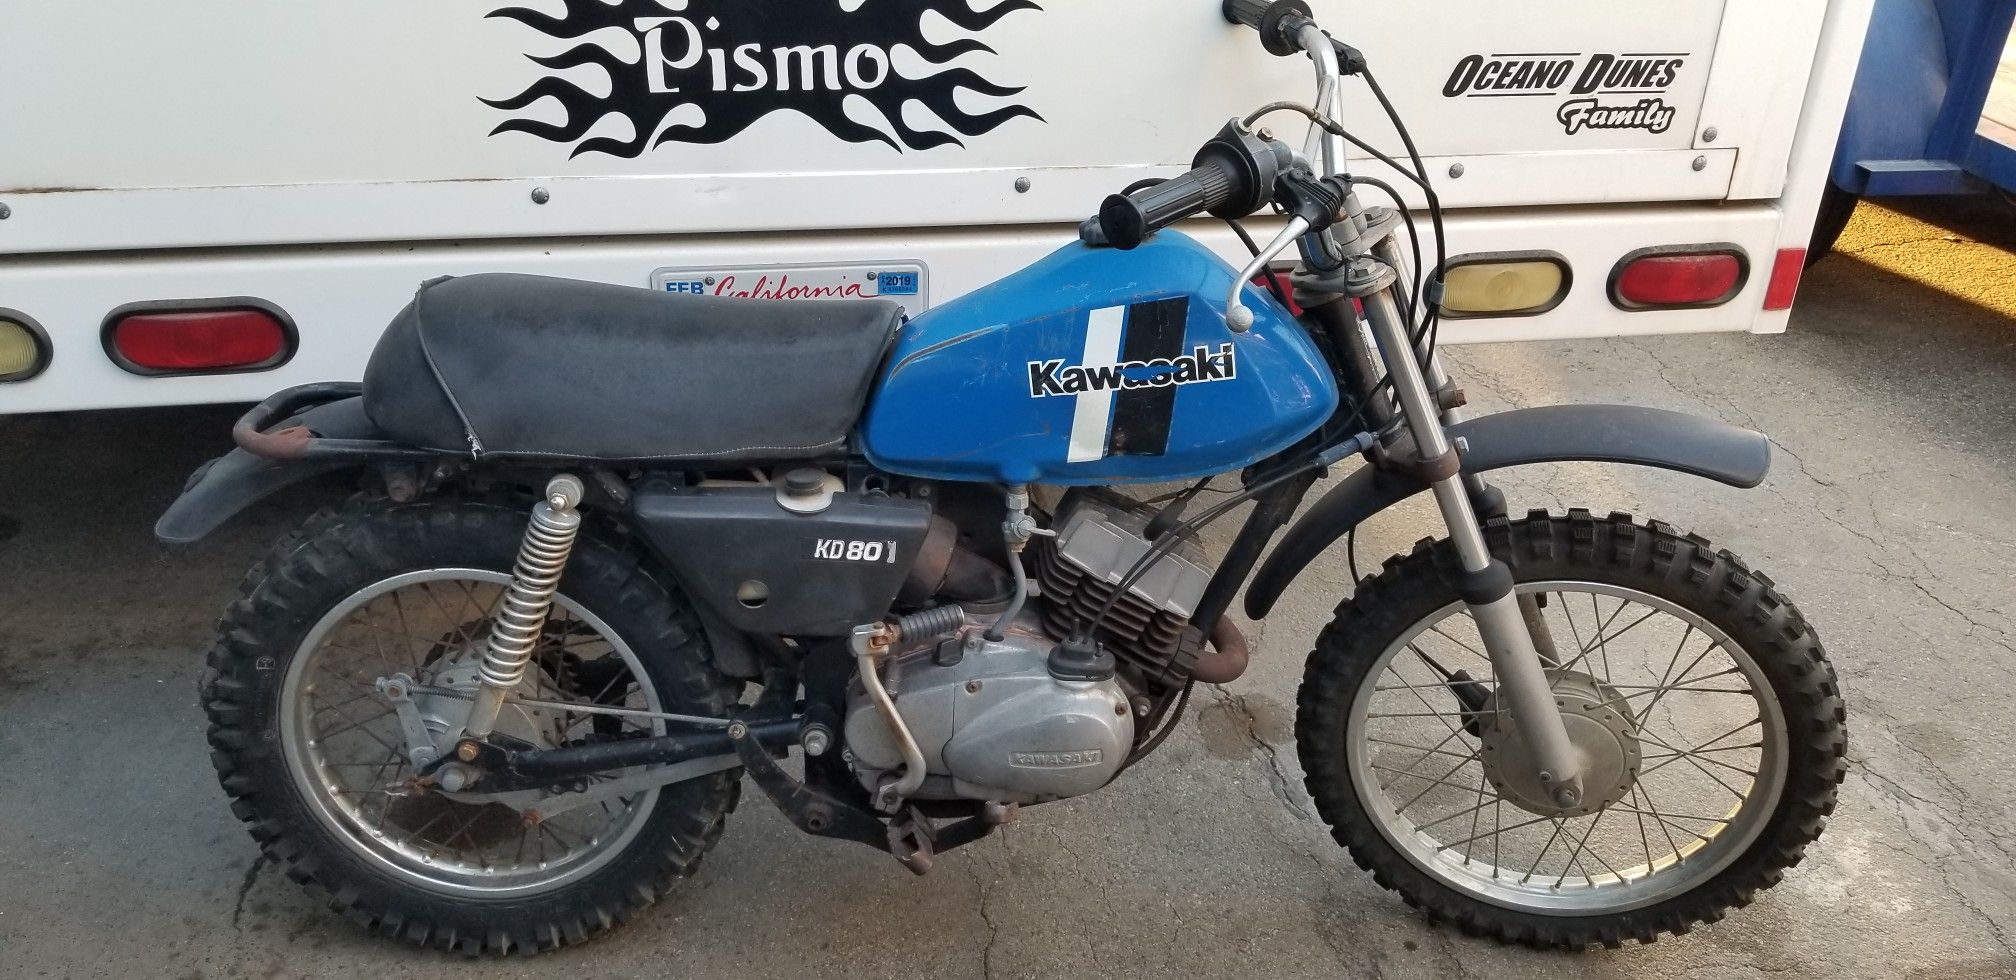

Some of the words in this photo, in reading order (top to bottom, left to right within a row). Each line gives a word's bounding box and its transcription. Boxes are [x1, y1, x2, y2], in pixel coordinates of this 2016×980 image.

[634, 16, 889, 93] Pismo
[1442, 54, 1575, 98] OCEANO
[1569, 53, 1684, 94] DUNES
[1557, 98, 1676, 135] Family
[714, 274, 880, 300] California
[886, 275, 911, 286] 2019
[1028, 343, 1236, 398] Kawasaki
